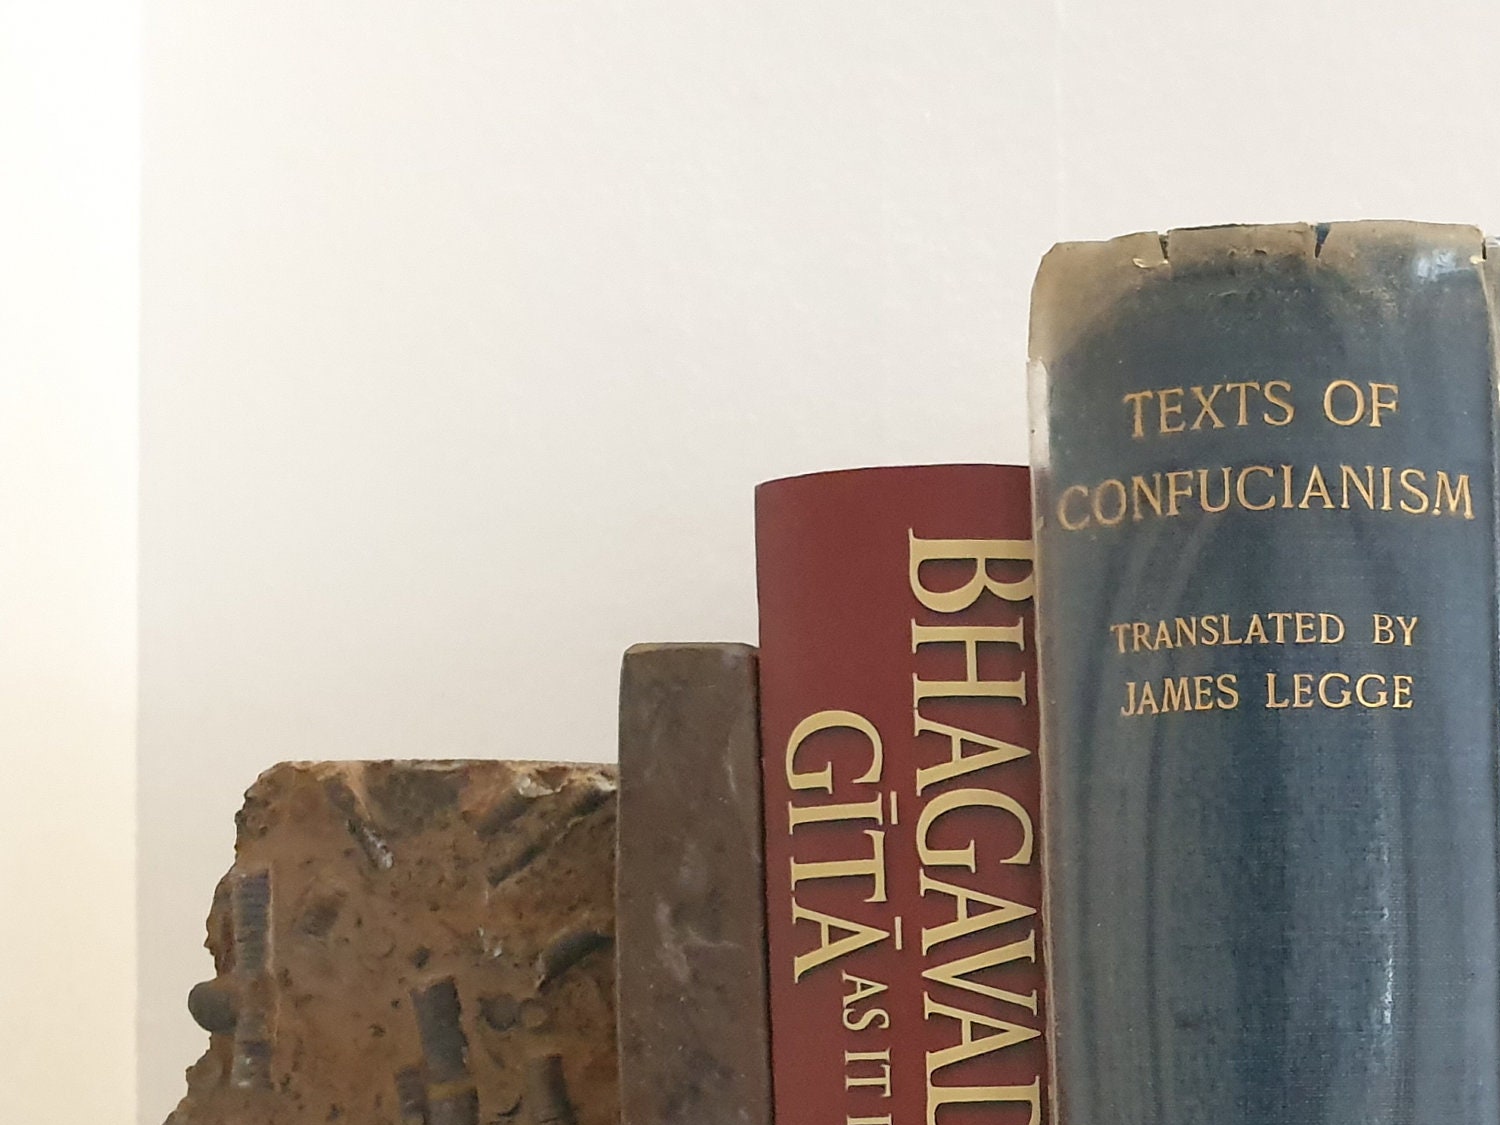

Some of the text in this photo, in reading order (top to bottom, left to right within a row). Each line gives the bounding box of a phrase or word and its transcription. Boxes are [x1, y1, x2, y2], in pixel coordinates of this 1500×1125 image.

[1122, 379, 1399, 439] TEXTS OF
[1056, 464, 1476, 532] CONFUCIANISM
[1110, 612, 1418, 654] TRANSLATED BY
[1120, 672, 1415, 717] JAMES LEGGE
[841, 969, 889, 1031] AS
[845, 1047, 892, 1097] IT
